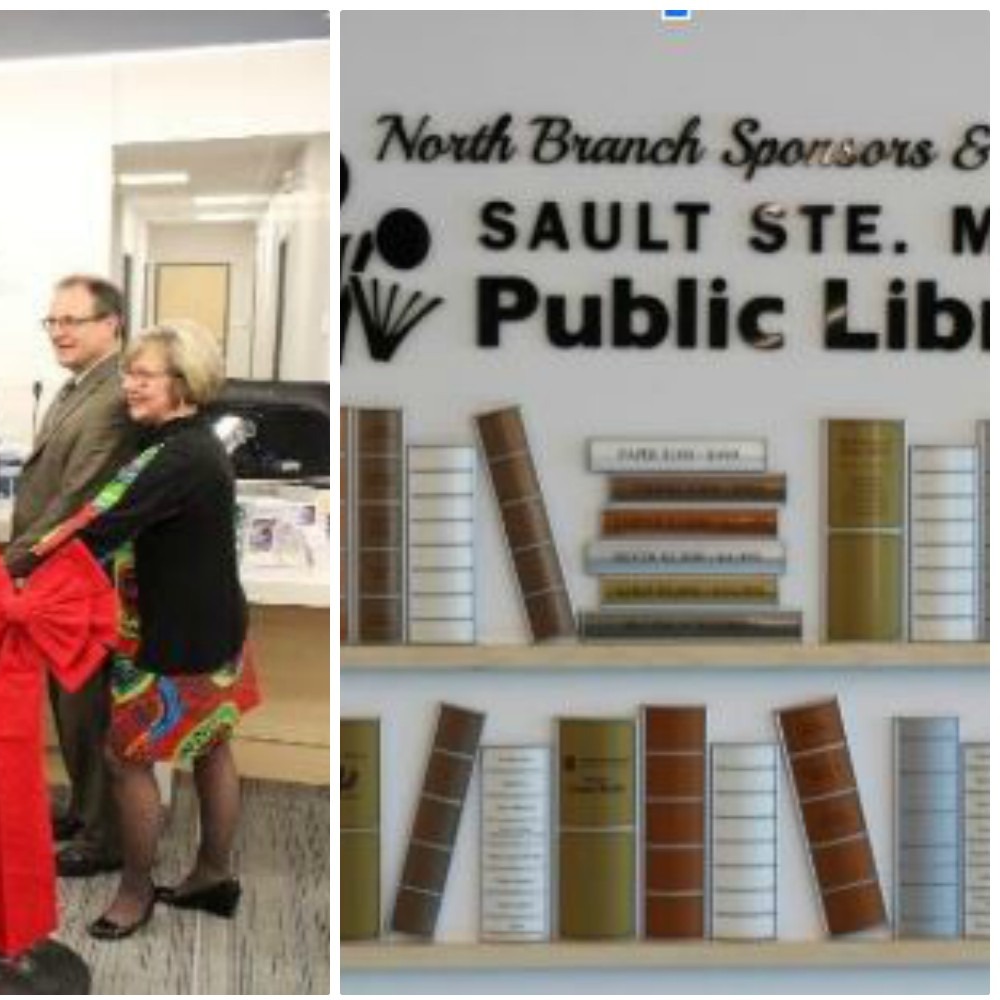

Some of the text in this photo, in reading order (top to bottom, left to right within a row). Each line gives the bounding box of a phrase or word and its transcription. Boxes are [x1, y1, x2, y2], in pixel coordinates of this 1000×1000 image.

[376, 112, 990, 182] North Branch Sponsors &
[477, 200, 711, 254] SAULT
[747, 203, 908, 255] STE.
[475, 274, 785, 351] Public
